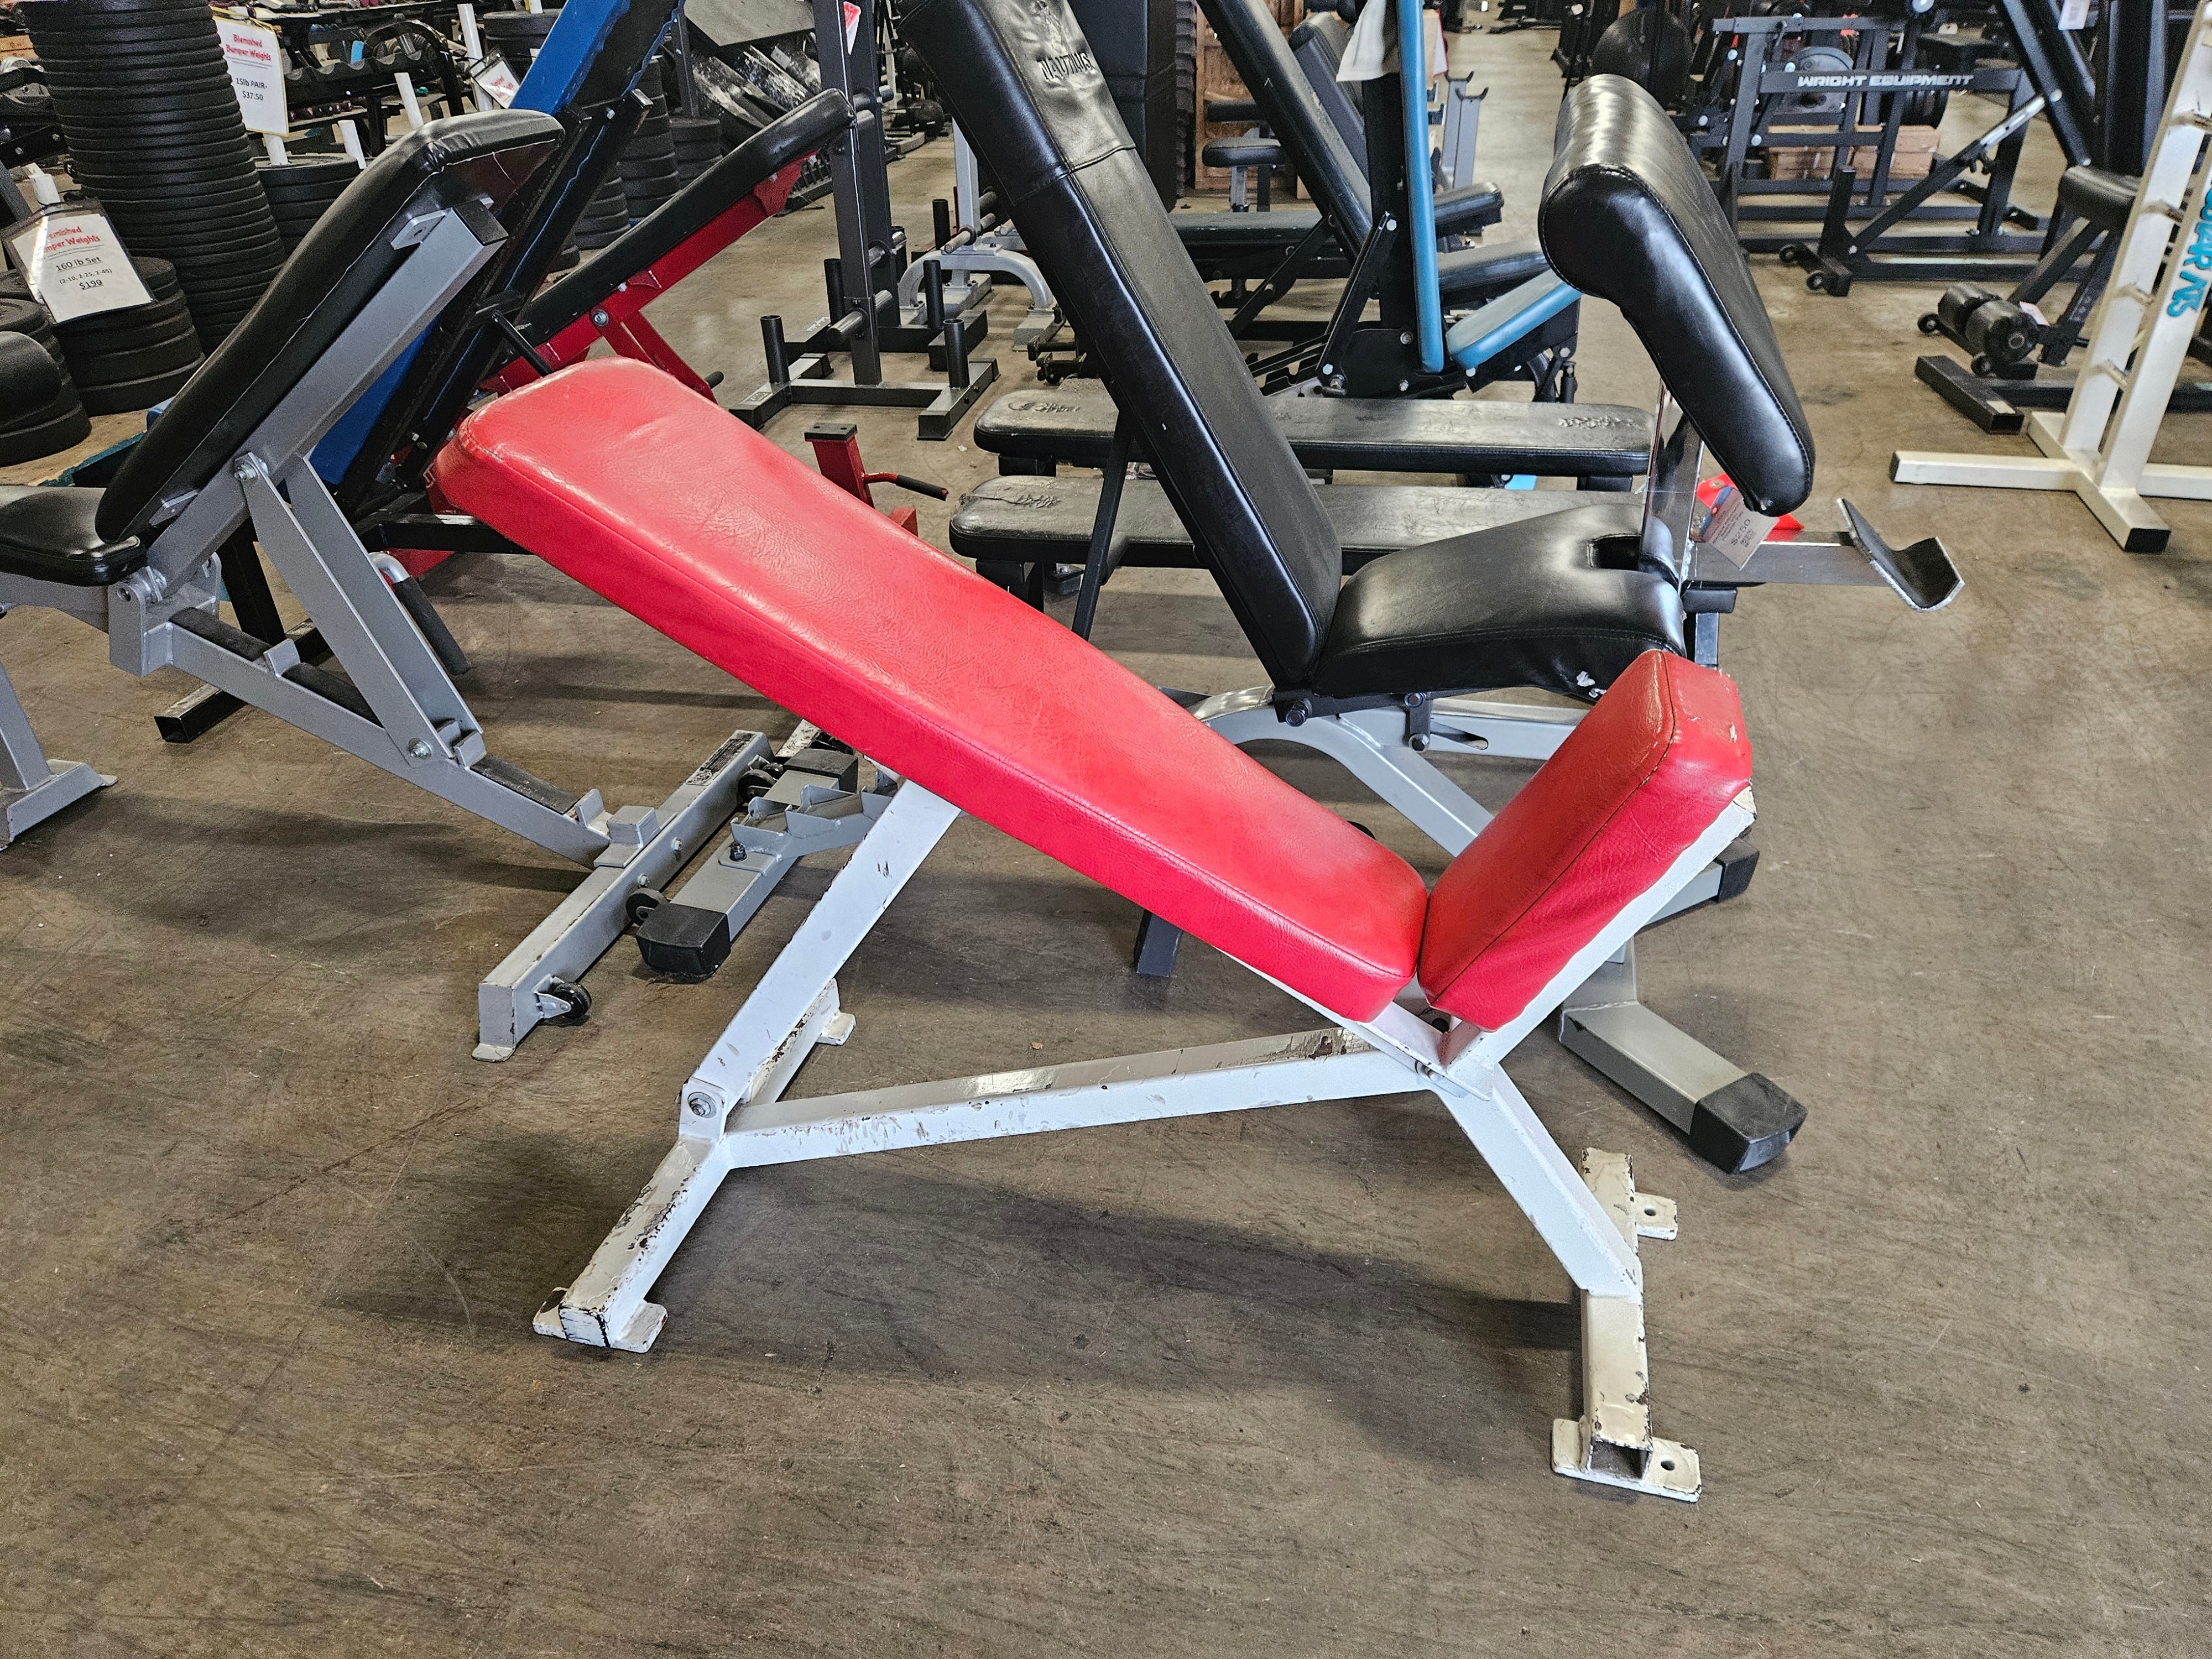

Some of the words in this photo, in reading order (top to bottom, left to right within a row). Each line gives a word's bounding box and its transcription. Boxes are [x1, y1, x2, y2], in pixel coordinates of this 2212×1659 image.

[233, 34, 263, 48] Blemished
[226, 44, 249, 56] Bumper
[249, 50, 271, 61] Weights
[1036, 51, 1095, 81] NAUTILUS
[236, 78, 249, 86] 15lb
[1798, 76, 1867, 87] WRIGHT
[1869, 75, 1974, 86] EQUIPMENT
[242, 91, 264, 101] $37.50
[48, 226, 82, 239] emished
[45, 241, 65, 252] mper
[65, 235, 101, 244] Weights
[56, 262, 73, 271] 160
[59, 275, 78, 285] (2-10,
[79, 279, 103, 290] $190
[1730, 519, 1751, 545] $250
